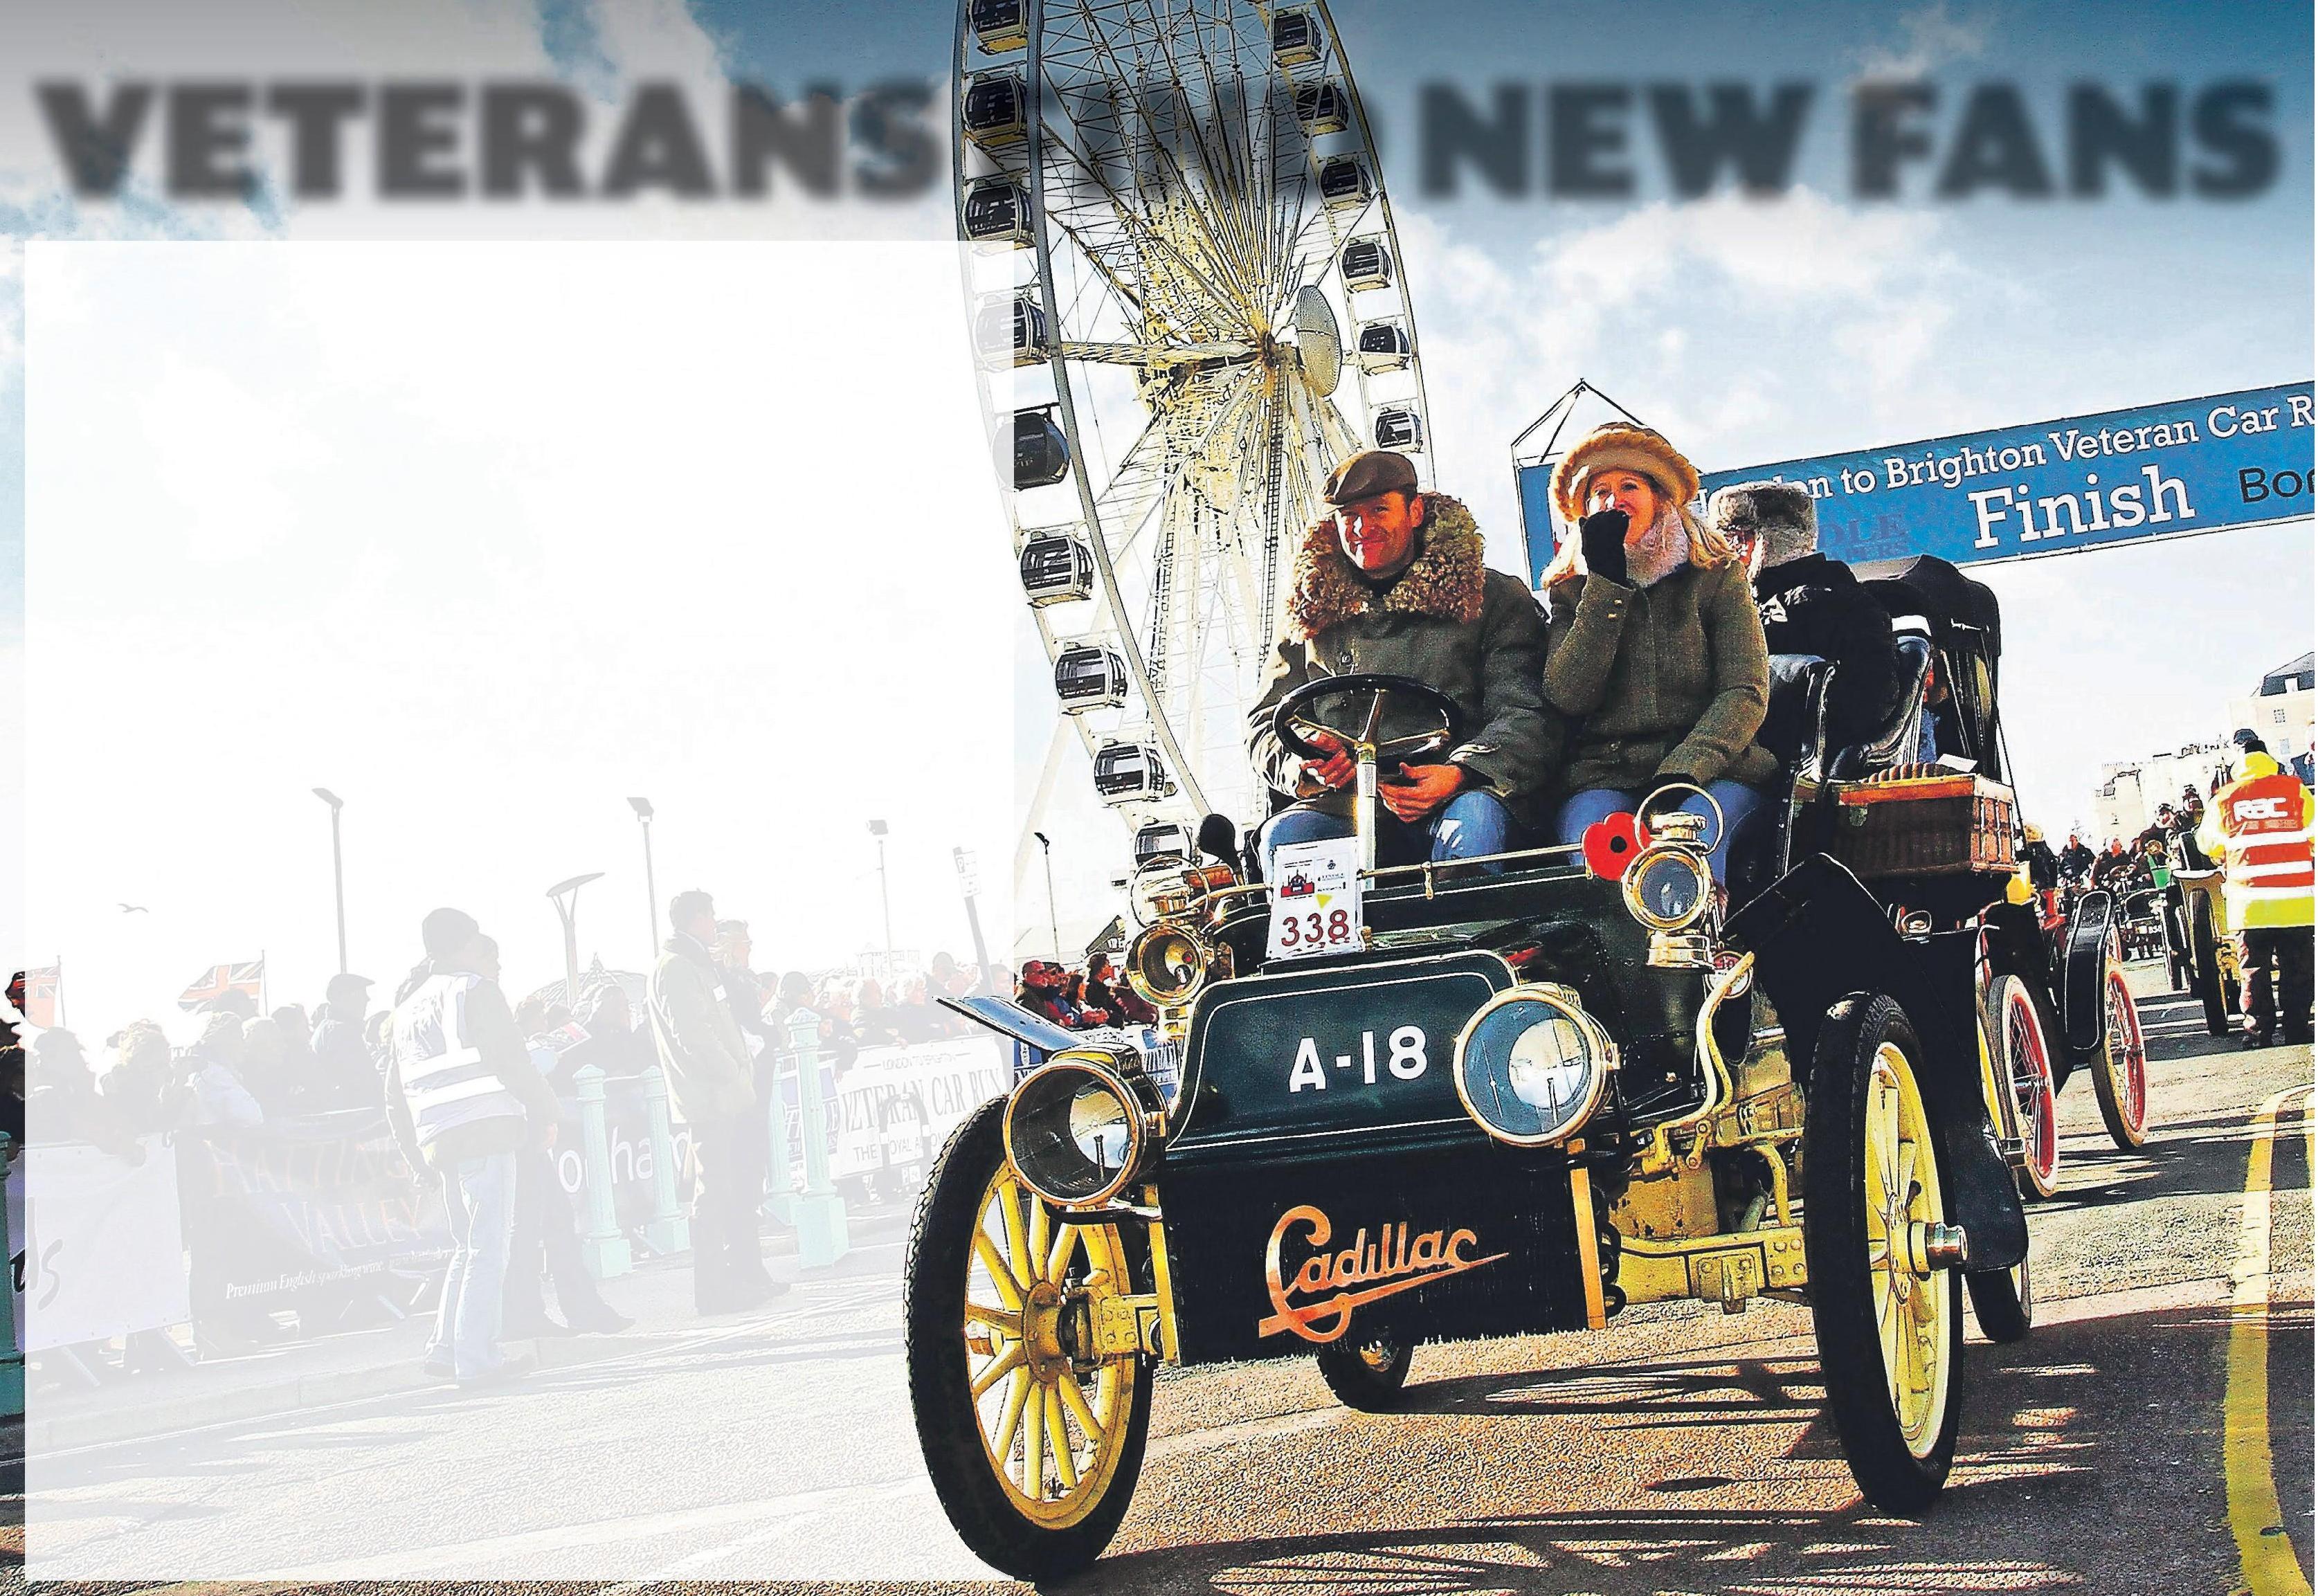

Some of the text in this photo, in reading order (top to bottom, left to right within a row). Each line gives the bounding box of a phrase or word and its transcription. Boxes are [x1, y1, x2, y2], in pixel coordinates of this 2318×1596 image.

[1840, 469, 1877, 496] to
[1884, 442, 2047, 489] Brighton
[2049, 419, 2200, 462] Veteran
[2207, 404, 2280, 439] Car
[1967, 464, 2197, 551] Finish
[1280, 909, 1350, 947] 338
[1289, 1025, 1427, 1094] A-18
[932, 1072, 967, 1116] CAR
[853, 1143, 878, 1162] THE
[279, 1195, 423, 1255] VALLEY
[226, 1280, 277, 1299] Premium
[280, 1269, 315, 1292] English
[1258, 1205, 1510, 1343] Cadillac
